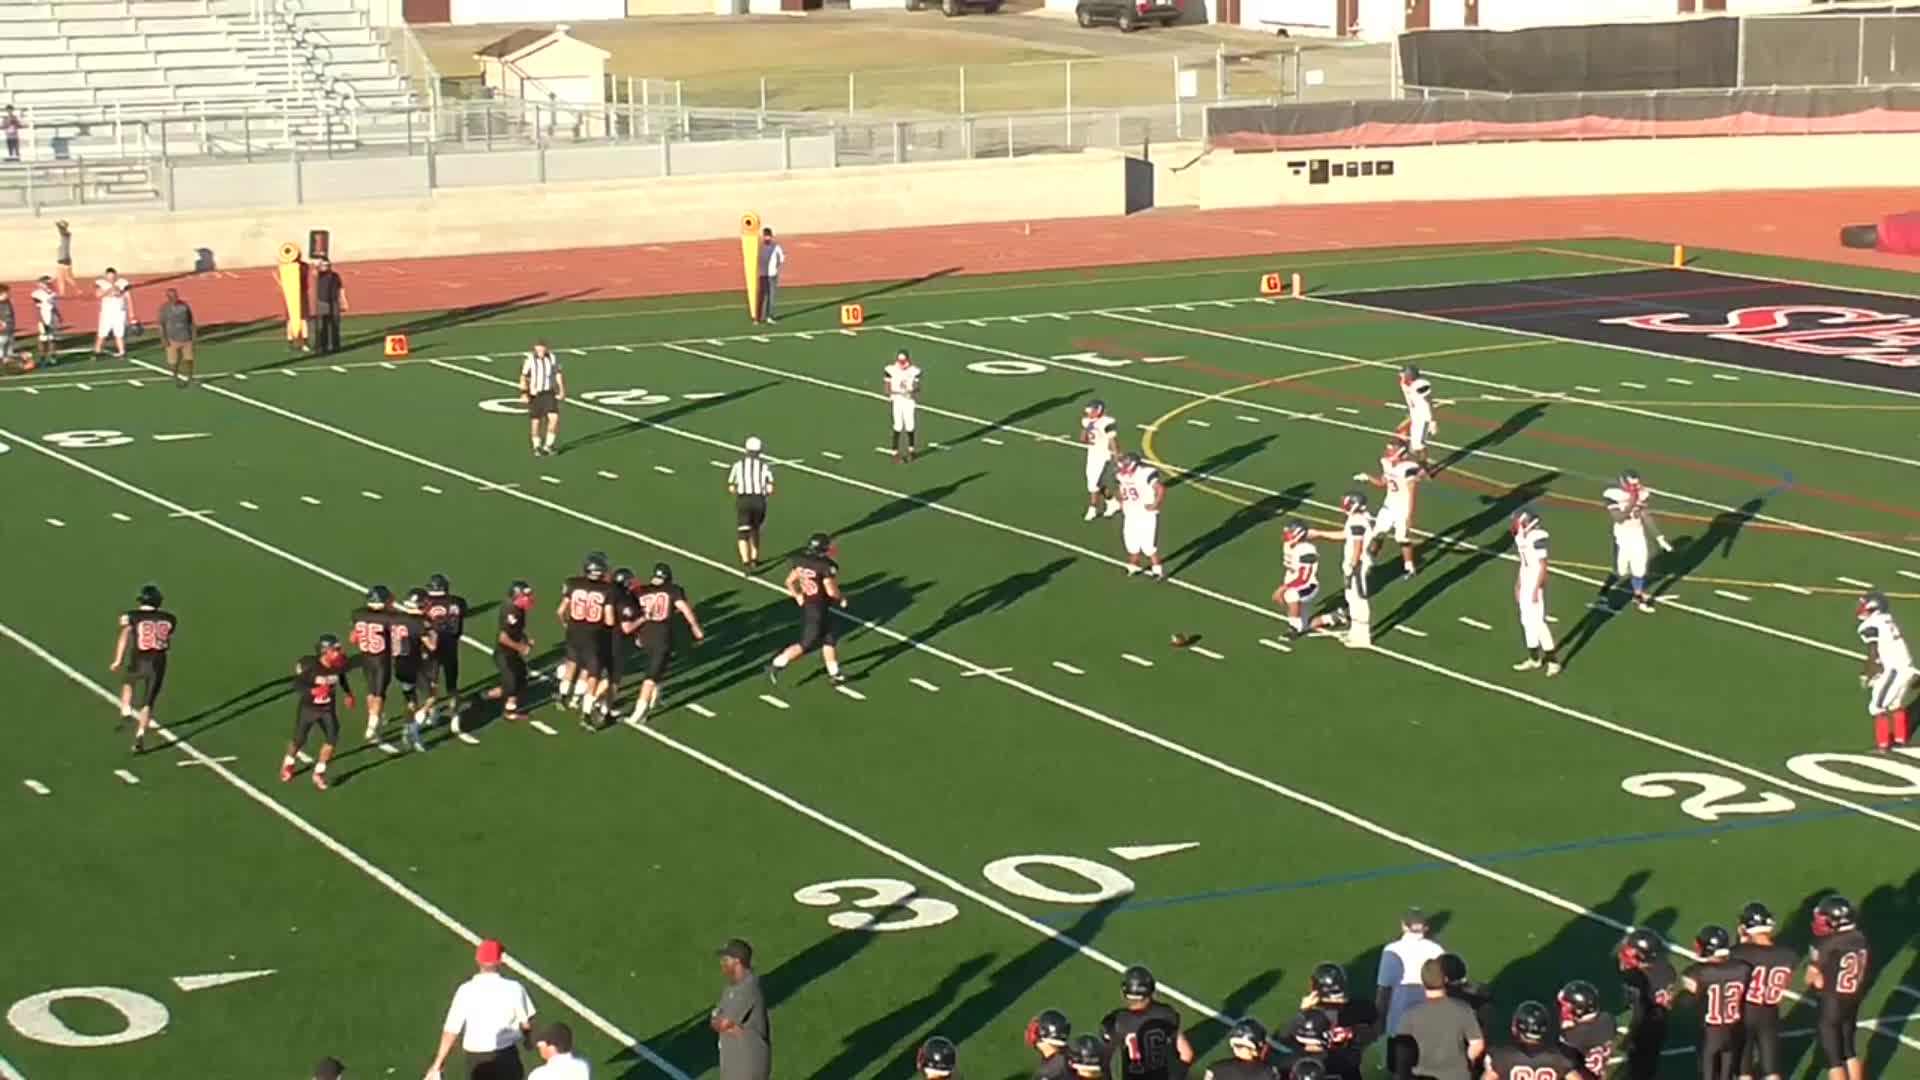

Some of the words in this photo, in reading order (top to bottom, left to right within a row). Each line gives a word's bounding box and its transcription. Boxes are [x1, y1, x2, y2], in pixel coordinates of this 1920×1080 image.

[845, 307, 860, 321] 10
[570, 588, 605, 622] 66
[1621, 752, 1920, 821] 20
[793, 854, 1136, 931] 30
[6, 985, 170, 1047] 0
[1704, 982, 1745, 1025] 12
